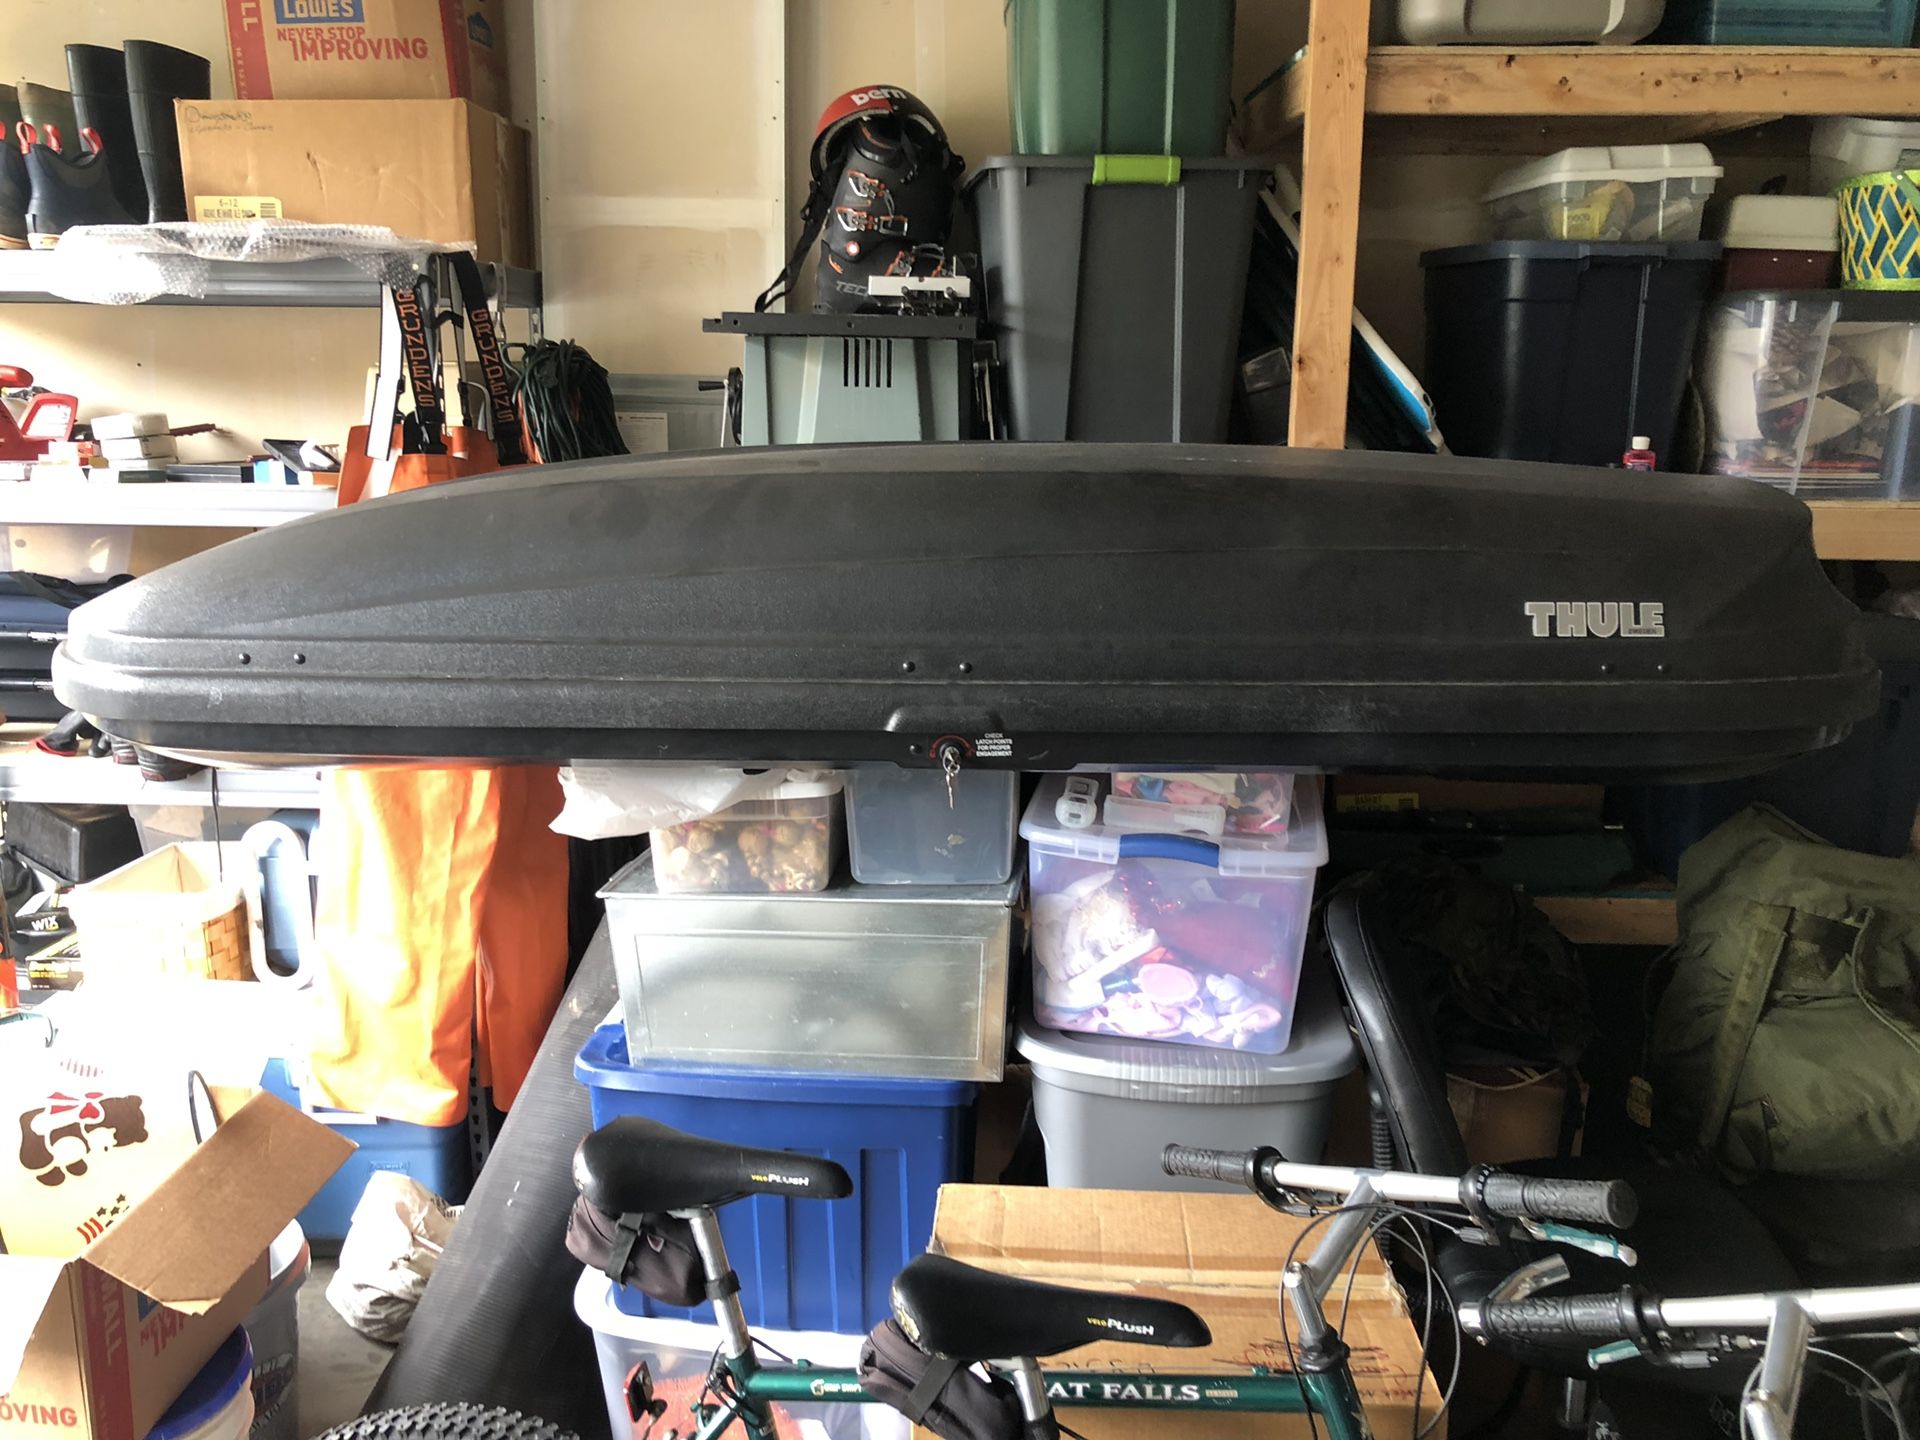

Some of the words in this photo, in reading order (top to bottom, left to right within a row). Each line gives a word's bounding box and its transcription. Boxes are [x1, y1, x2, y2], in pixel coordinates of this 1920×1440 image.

[276, 27, 324, 41] NEVER
[327, 26, 365, 40] STOP
[291, 37, 429, 62] IMPROVING
[851, 89, 907, 106] bern
[836, 281, 869, 298] TEC
[1524, 602, 1665, 638] THULE
[31, 915, 58, 931] WIX
[1107, 1318, 1155, 1336] PLUSH
[1044, 1382, 1091, 1399] AT
[1103, 1383, 1200, 1401] FALLS
